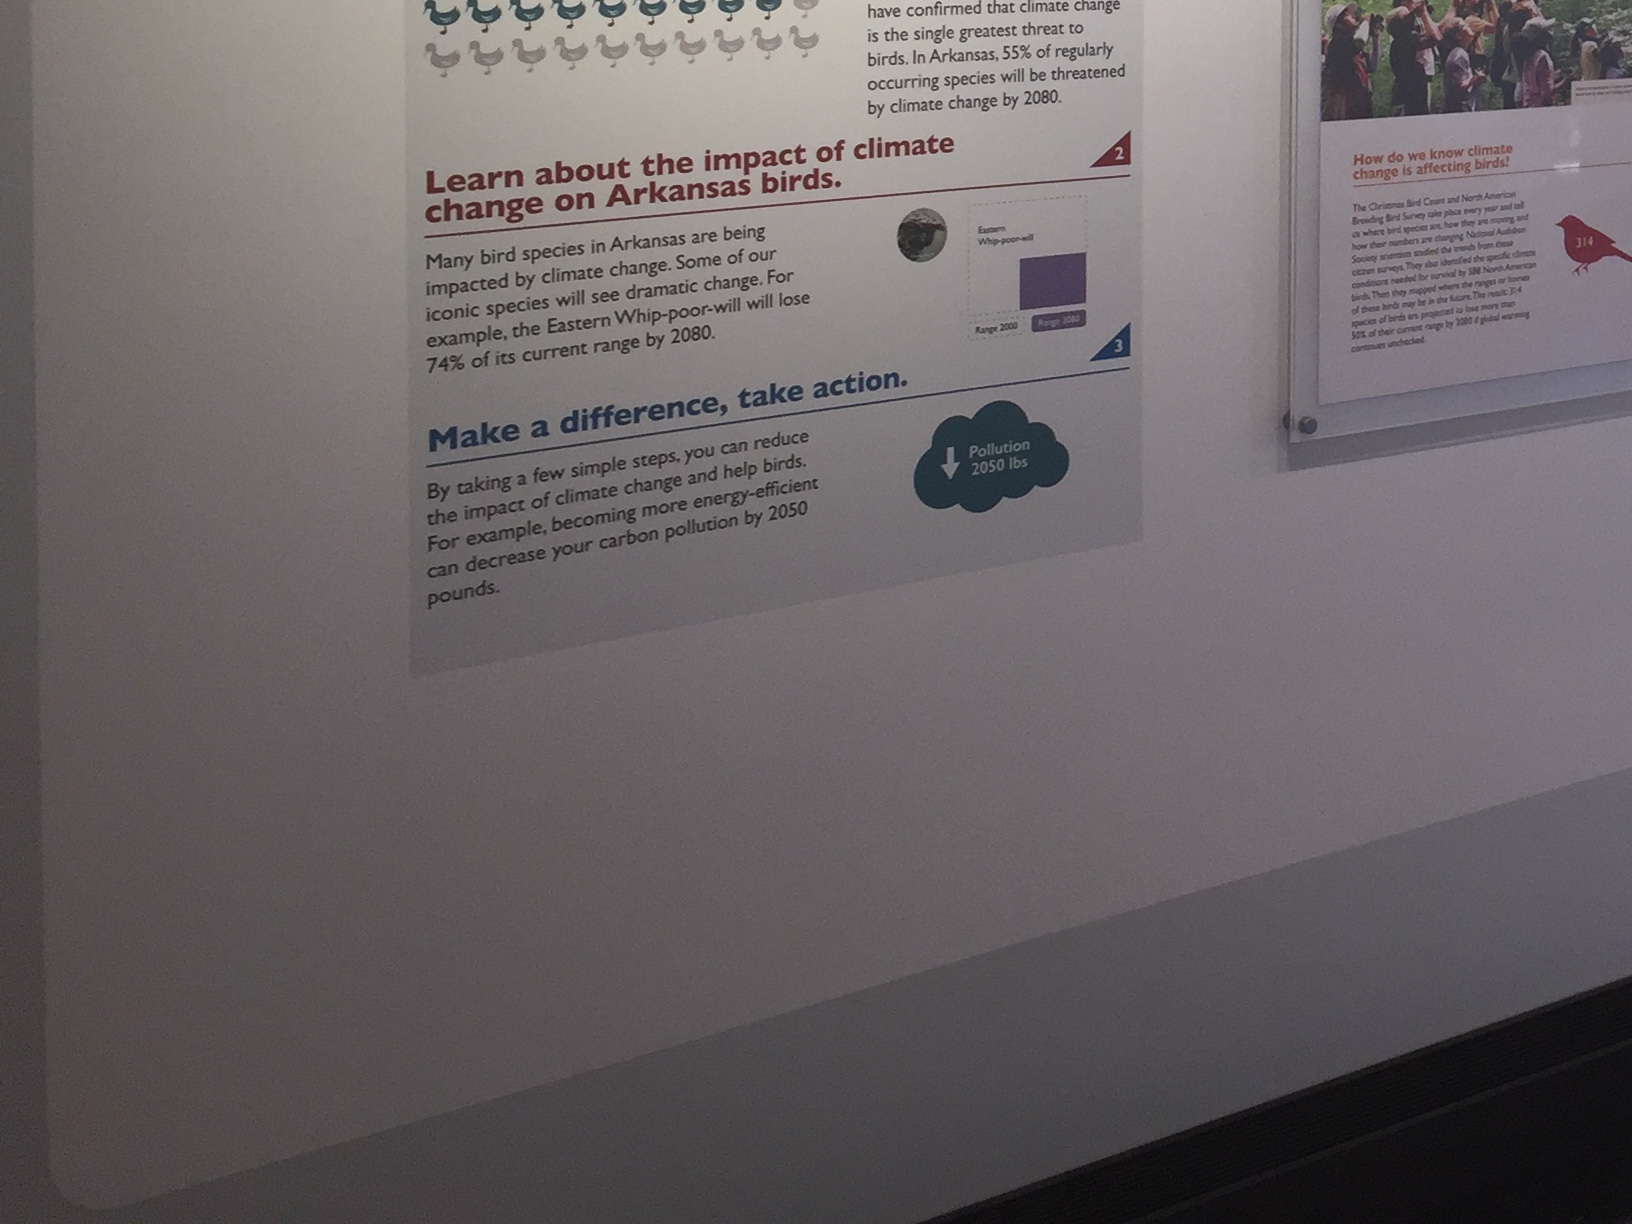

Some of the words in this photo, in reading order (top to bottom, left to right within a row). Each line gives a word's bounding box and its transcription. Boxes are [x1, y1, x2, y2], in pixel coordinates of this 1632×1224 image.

[1115, 146, 1124, 160] 2
[1353, 153, 1384, 166] How
[1387, 151, 1404, 163] do
[1407, 152, 1426, 161] we
[1430, 148, 1465, 160] know
[1467, 144, 1513, 157] climate
[426, 170, 524, 194] Learn
[535, 157, 631, 185] about
[640, 153, 693, 177] the
[705, 144, 807, 175] impact
[816, 139, 846, 163] of
[854, 134, 954, 160] climate
[1353, 168, 1399, 180] change
[1402, 164, 1413, 176] is
[1416, 161, 1471, 175] affecting
[425, 197, 543, 223] change
[555, 192, 595, 211] on
[605, 179, 751, 207] Arkansas
[762, 168, 842, 194] birds.
[978, 226, 1006, 234] Eastern
[1576, 236, 1593, 248] 314
[1114, 338, 1123, 352] 3
[429, 422, 520, 452] Make
[531, 420, 550, 438] a
[560, 397, 728, 434] difference,
[737, 383, 804, 409] take
[813, 371, 908, 399] action.
[969, 440, 1030, 459] Pollution
[971, 458, 1005, 476] 2050
[1009, 456, 1028, 469] lbs
